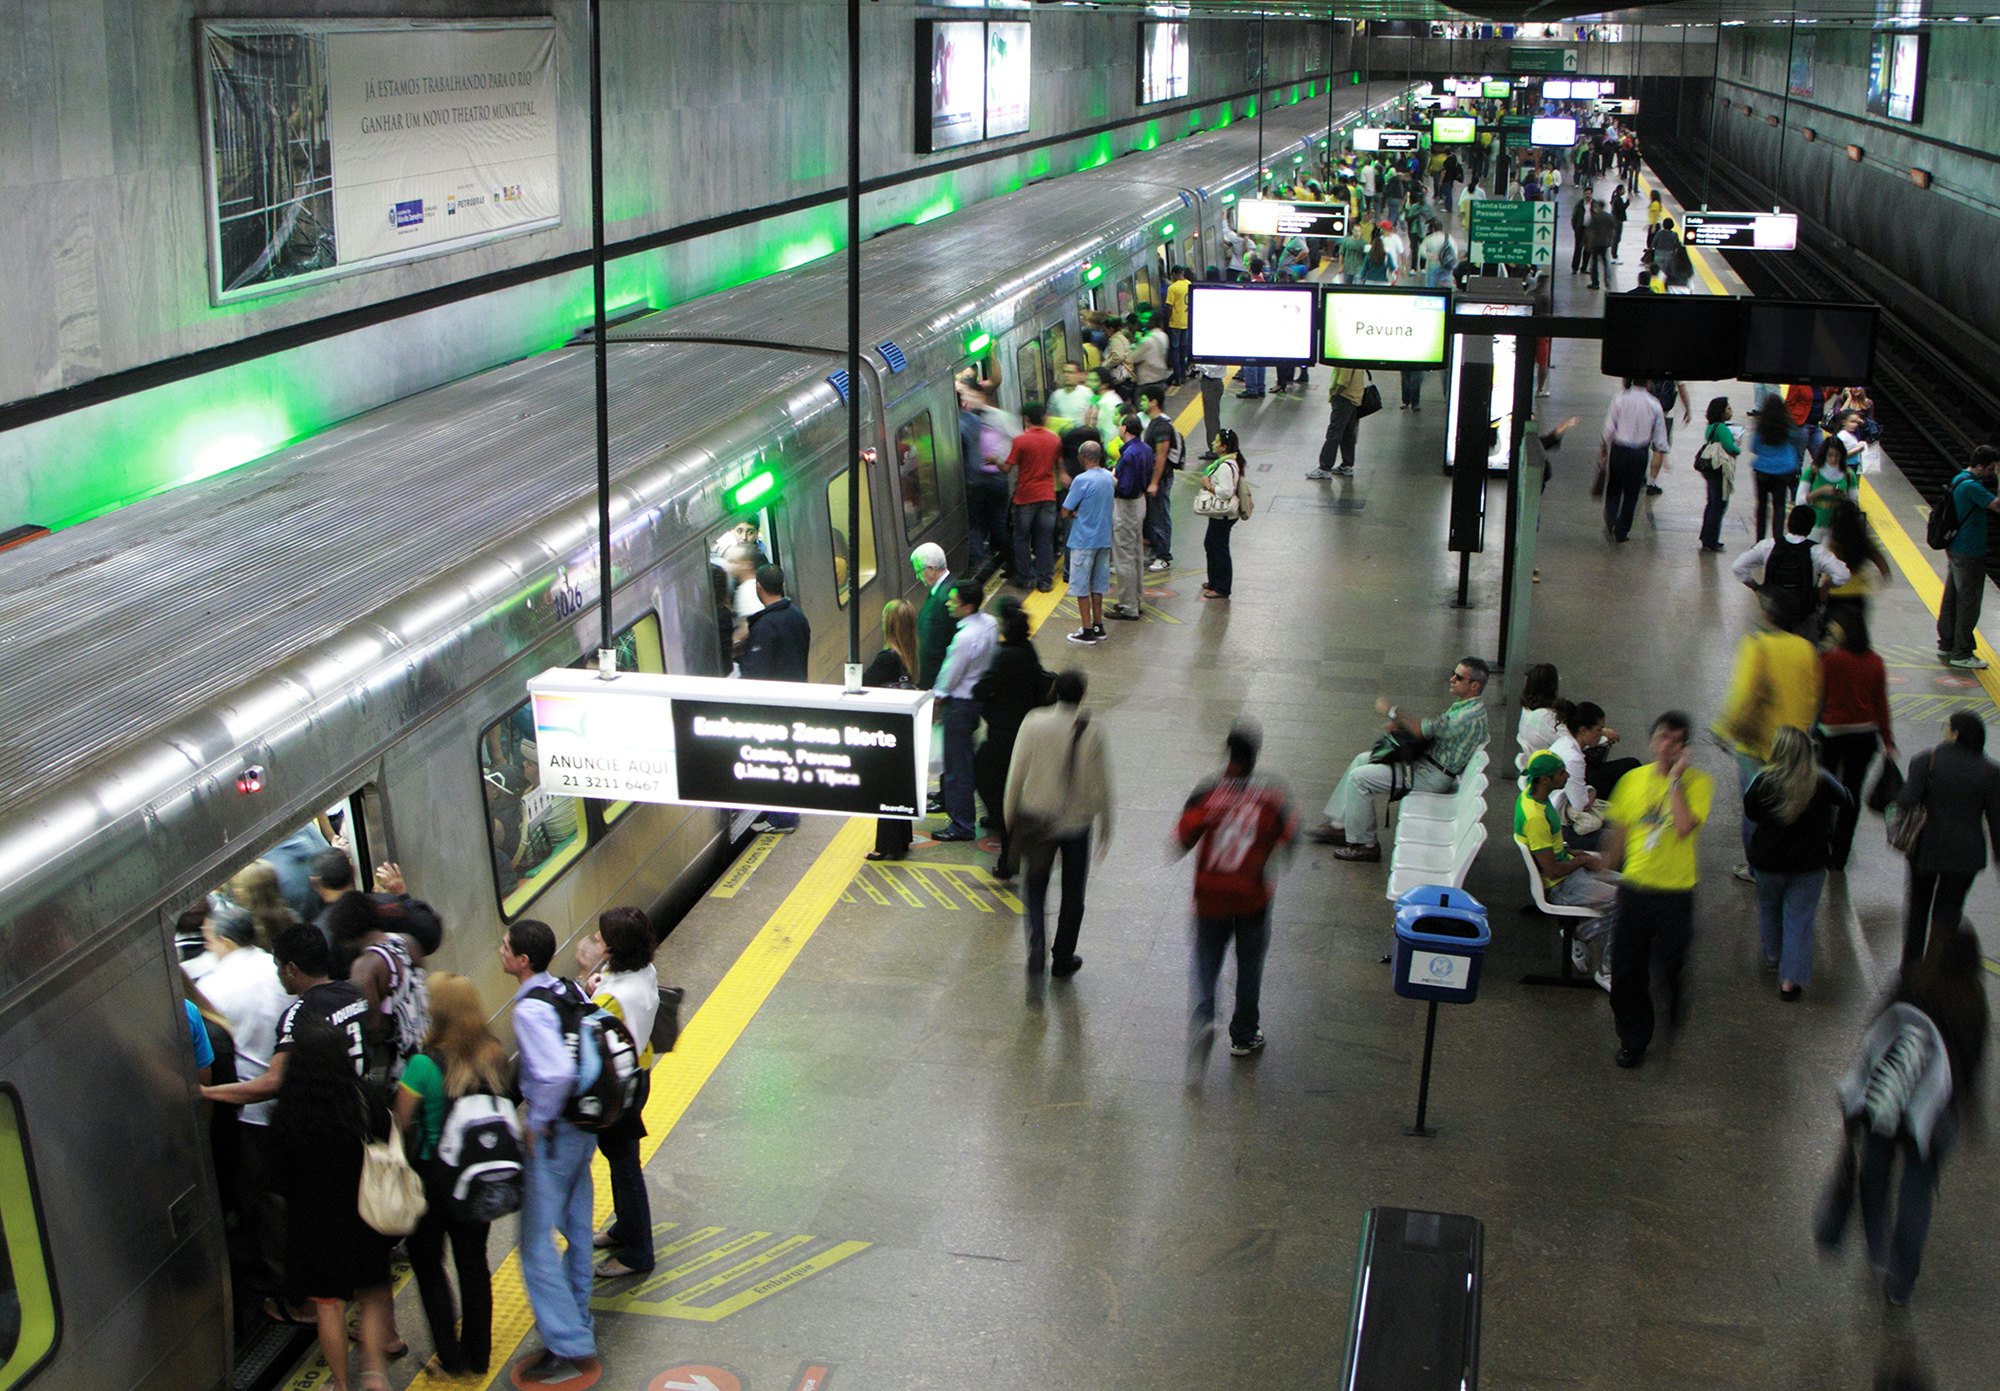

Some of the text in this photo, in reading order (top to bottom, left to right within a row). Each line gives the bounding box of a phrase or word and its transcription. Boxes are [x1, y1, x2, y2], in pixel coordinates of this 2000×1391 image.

[378, 79, 421, 97] ESTAMOS
[422, 74, 487, 94] TRABALHANDO
[488, 71, 509, 89] PARA
[509, 71, 517, 87] O
[518, 70, 533, 87] RIO
[361, 101, 537, 134] GANHAR UM NOVO THEATRO MUNICIPAL
[457, 196, 485, 209] PETROBRAS
[1355, 321, 1413, 337] Pavuna
[553, 580, 583, 621] 1026
[694, 716, 897, 748] Embarque Zona Norte
[550, 754, 669, 776] ANUNCIE AQUI
[796, 749, 851, 767] Pavuna
[562, 775, 659, 790] 21 3211 6467
[733, 762, 780, 779] (Linha
[782, 765, 799, 783] 2)
[816, 768, 861, 787] Tijuca
[880, 803, 914, 814] Boarding
[753, 1263, 815, 1295] Embarque
